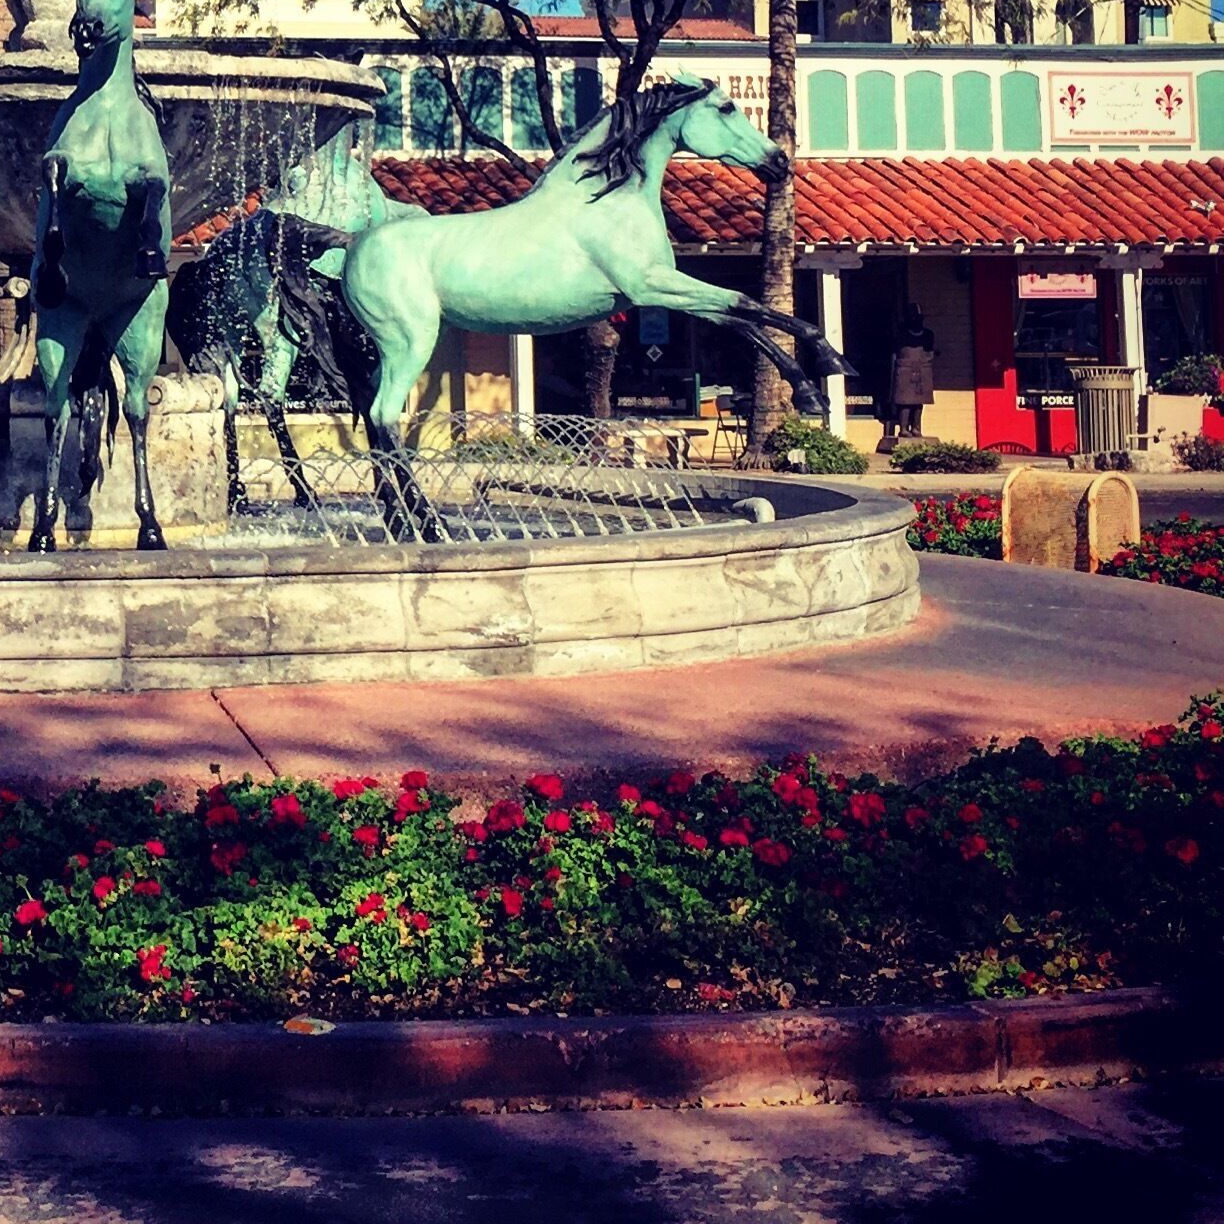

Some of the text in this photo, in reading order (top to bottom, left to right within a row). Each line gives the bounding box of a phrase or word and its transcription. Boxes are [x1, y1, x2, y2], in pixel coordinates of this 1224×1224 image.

[729, 75, 771, 99] HAI
[1174, 277, 1187, 286] OF
[1016, 395, 1074, 406] FINE PORCE
